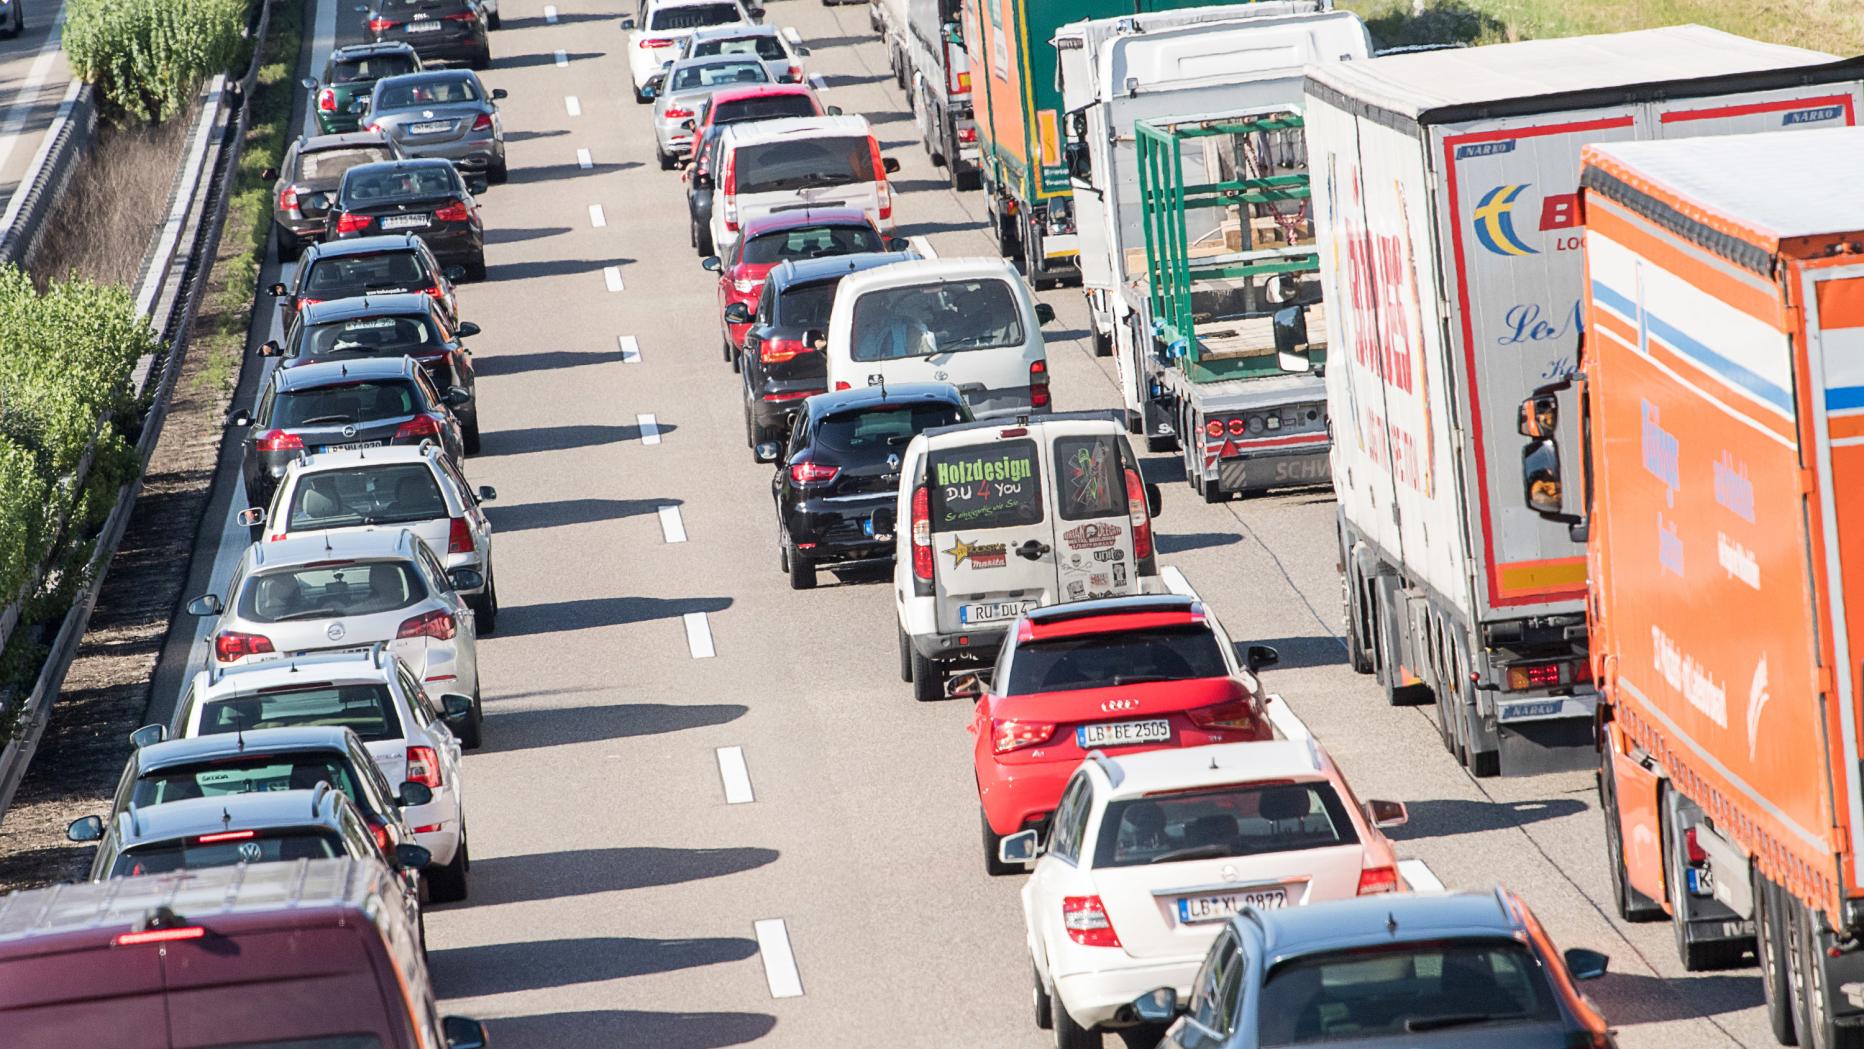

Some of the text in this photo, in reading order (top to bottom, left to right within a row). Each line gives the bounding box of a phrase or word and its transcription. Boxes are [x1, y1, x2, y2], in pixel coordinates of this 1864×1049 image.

[1791, 109, 1834, 123] NARKO
[1465, 143, 1507, 157] NARKO
[937, 456, 1031, 485] Holzdesign
[977, 480, 990, 502] 4
[976, 606, 992, 619] RU
[1002, 604, 1018, 617] DU
[1513, 704, 1552, 716] NARKO
[1088, 720, 1168, 742] LB BE 2505
[1191, 899, 1211, 916] LB
[1222, 896, 1239, 912] XL
